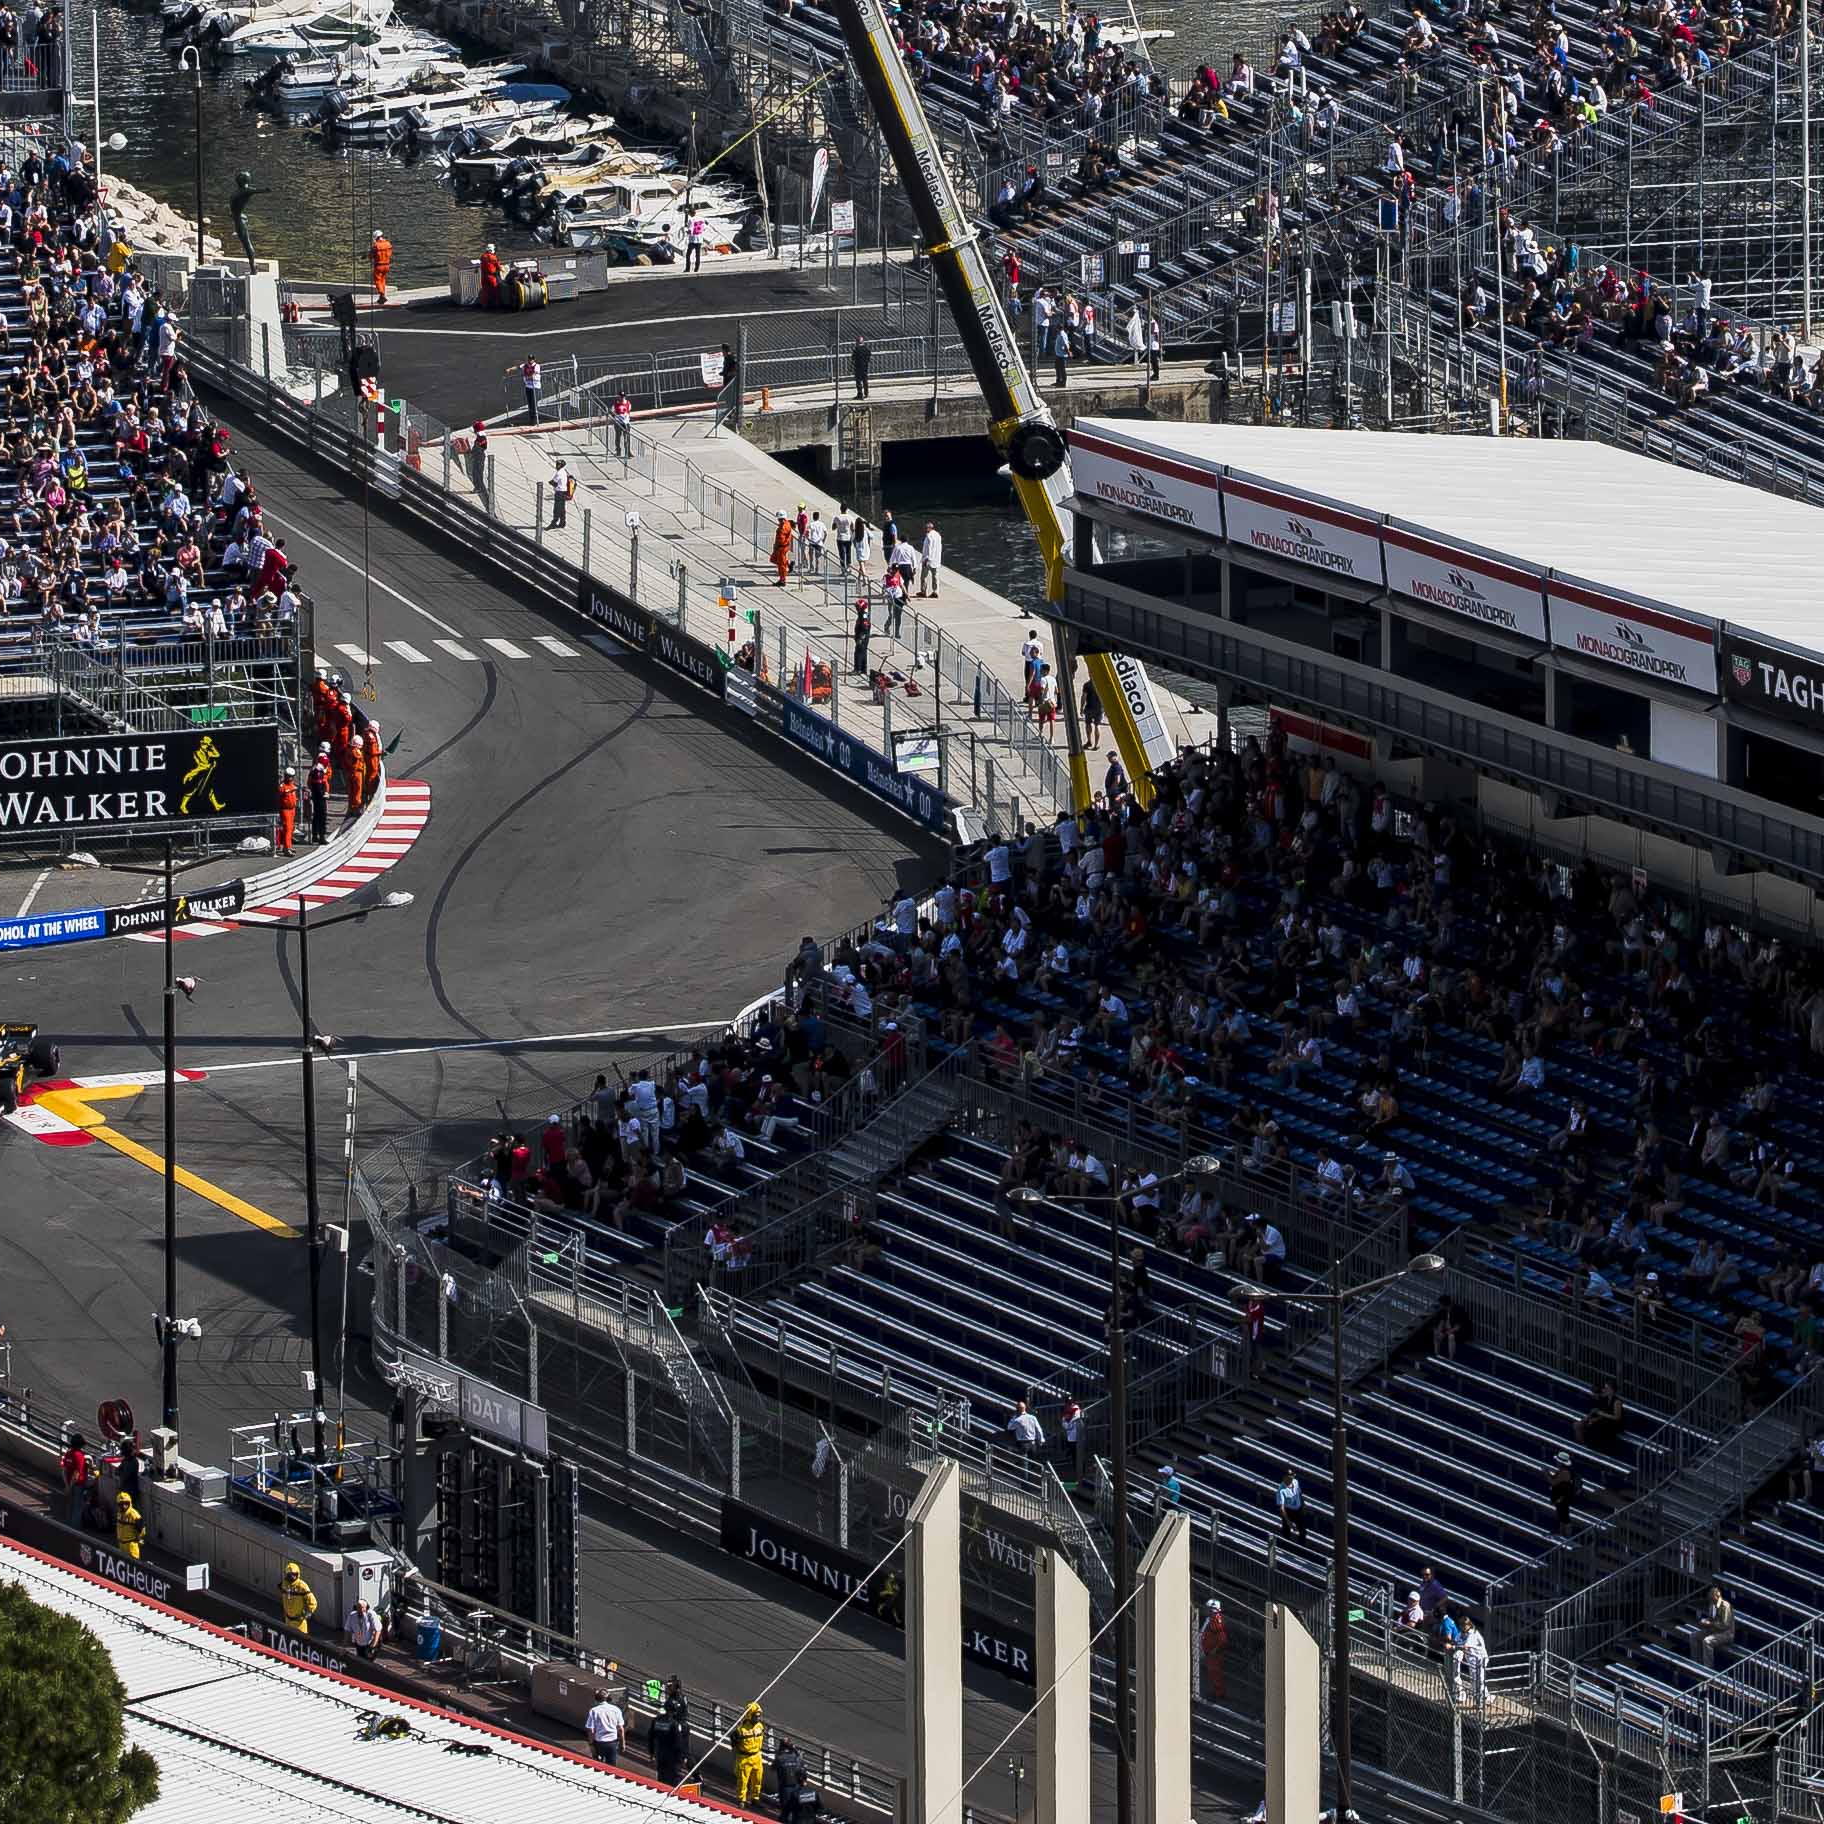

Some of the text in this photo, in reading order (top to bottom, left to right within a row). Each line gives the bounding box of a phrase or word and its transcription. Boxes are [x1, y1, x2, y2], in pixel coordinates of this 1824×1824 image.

[916, 150, 945, 208] Mediaco
[978, 305, 1009, 370] Mediaco
[589, 593, 715, 686] JOHNNIE WALKER
[1111, 651, 1146, 716] ediaco
[788, 707, 824, 754] Heineken
[866, 760, 903, 801] Heineken
[28, 922, 40, 938] AT
[43, 920, 62, 936] THE
[64, 915, 99, 934] WHEEL
[113, 896, 235, 931] JOHNNI WALKER
[746, 1526, 870, 1604] JOHNNIE
[963, 1626, 1029, 1673] LKER
